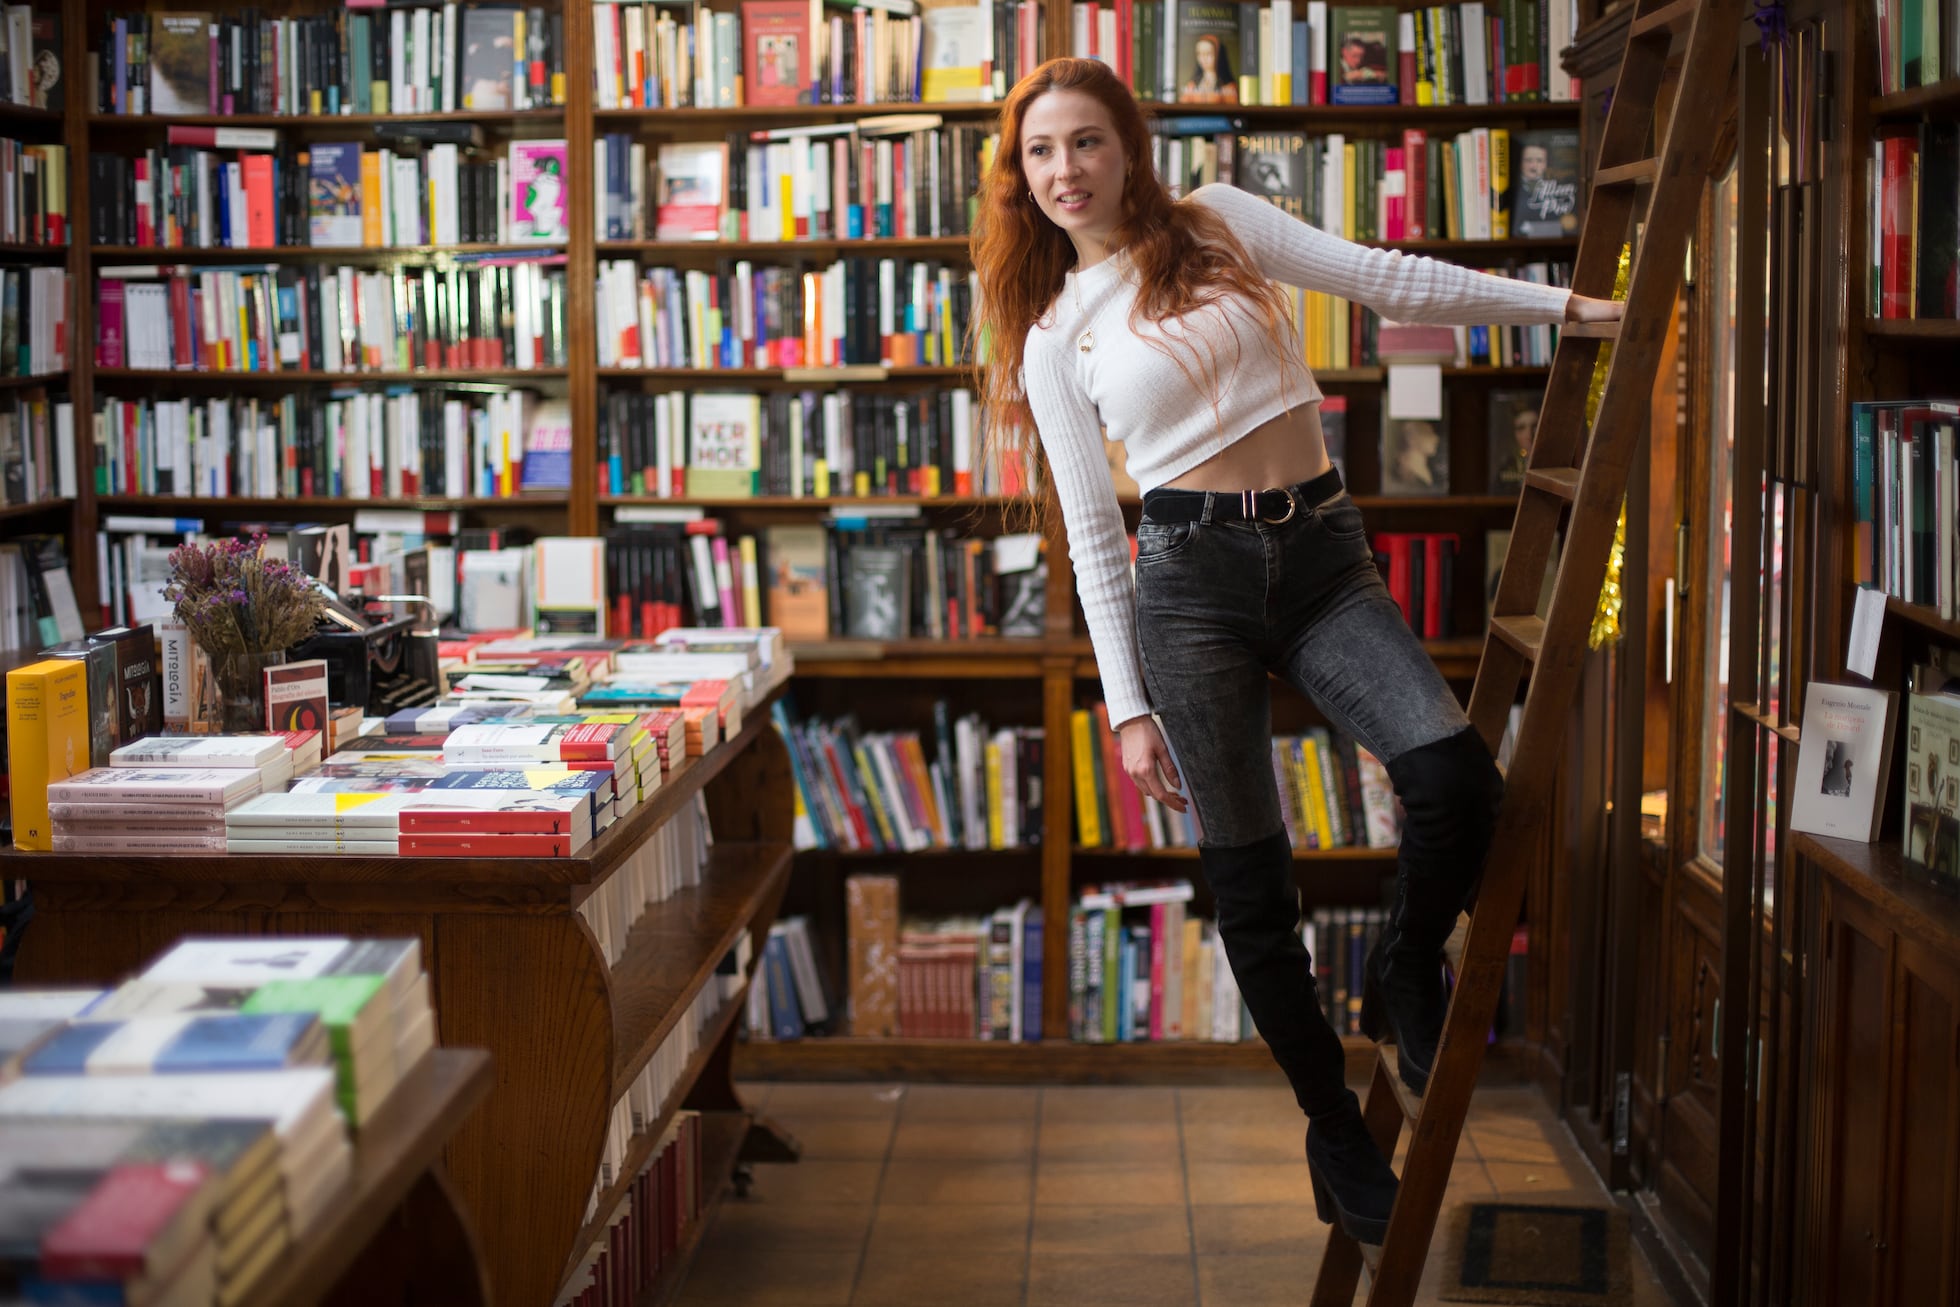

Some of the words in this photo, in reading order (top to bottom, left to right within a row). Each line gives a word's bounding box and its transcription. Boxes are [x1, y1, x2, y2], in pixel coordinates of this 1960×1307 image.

[1238, 136, 1303, 154] PHILIP
[124, 660, 150, 681] MITOLOGÍA
[168, 639, 182, 704] MITOLOGÍA
